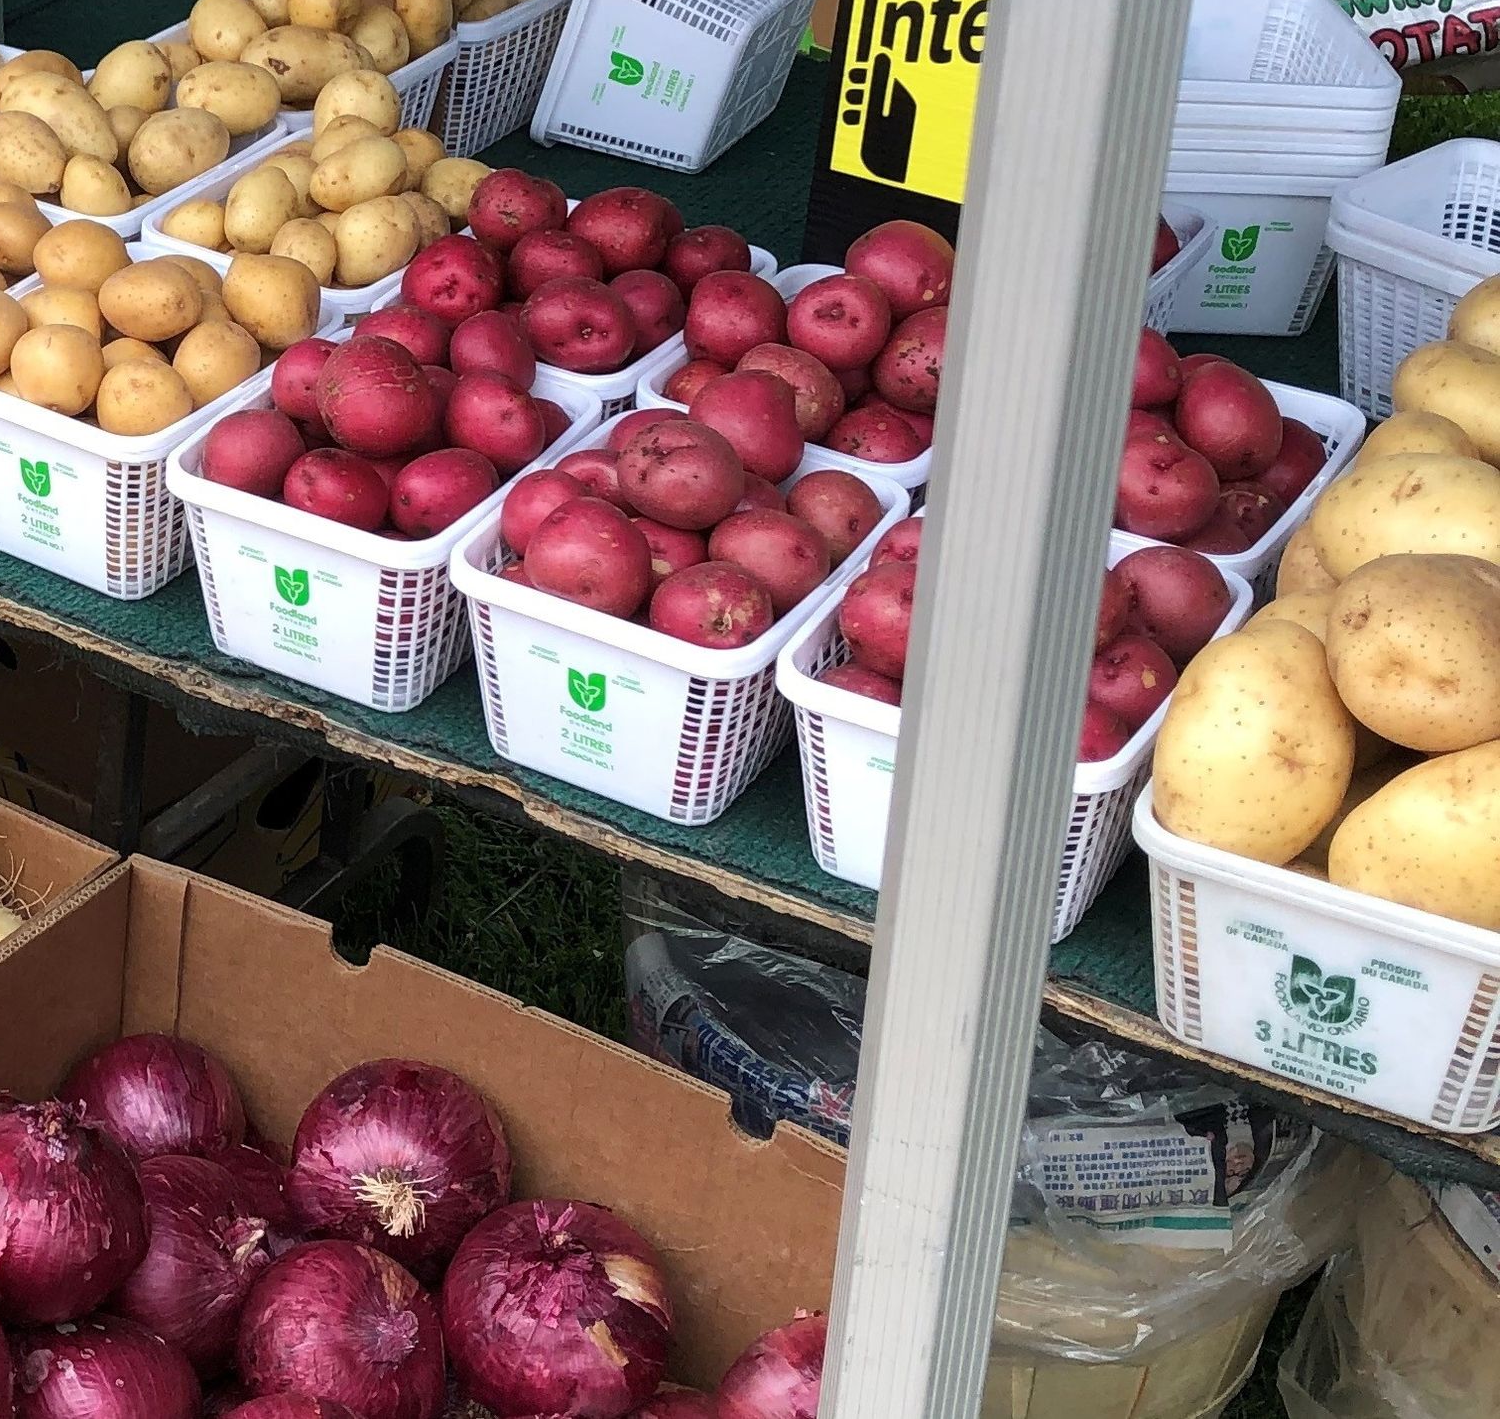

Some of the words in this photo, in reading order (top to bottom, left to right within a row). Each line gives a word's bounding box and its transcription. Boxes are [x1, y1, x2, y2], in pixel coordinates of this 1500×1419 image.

[1203, 284, 1212, 295] 2
[1215, 284, 1251, 295] LITRES
[20, 513, 28, 524] 2
[30, 517, 61, 537] LITRES
[269, 601, 318, 626] Foodland
[272, 623, 280, 634] 2
[283, 626, 319, 648] LITRES
[559, 705, 613, 732] Foodland
[561, 727, 569, 740] 2
[573, 731, 613, 755] LITRES
[1243, 931, 1289, 952] CANADA
[1361, 966, 1378, 978] DU
[1380, 971, 1429, 993] CANADA
[1371, 958, 1423, 980] PRODUIT
[1255, 1020, 1272, 1042] 3
[1281, 1028, 1378, 1076] LITRES
[1271, 1059, 1323, 1084] CANADA
